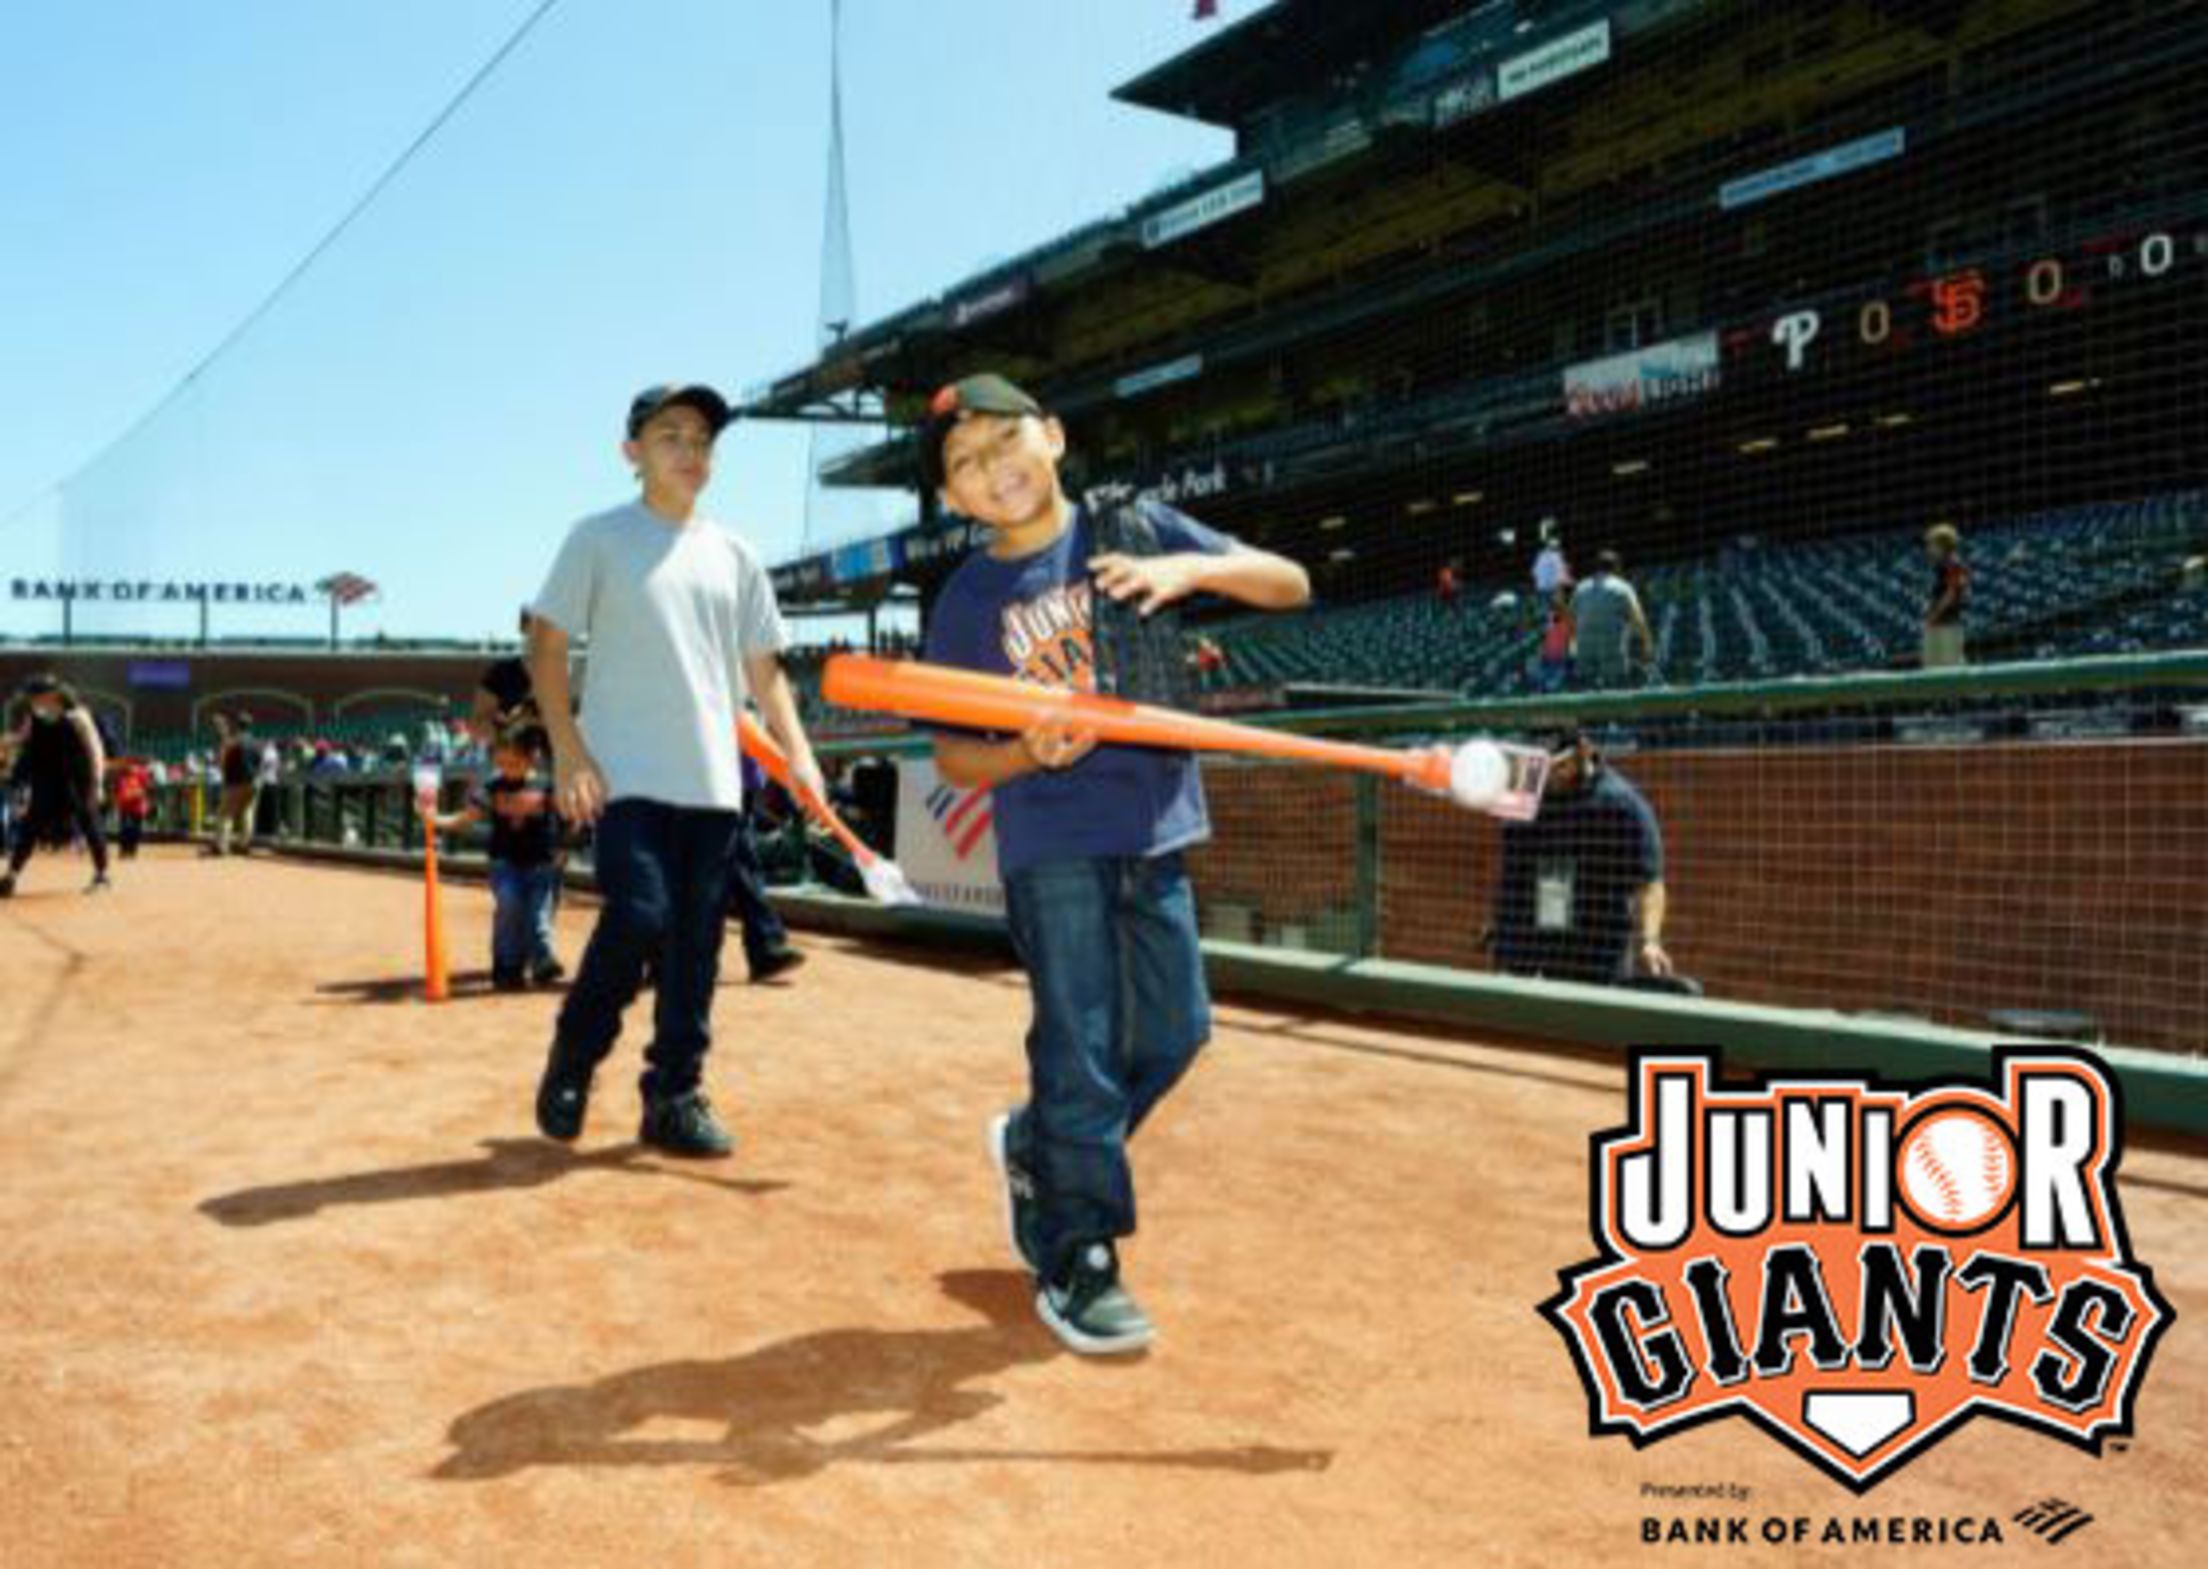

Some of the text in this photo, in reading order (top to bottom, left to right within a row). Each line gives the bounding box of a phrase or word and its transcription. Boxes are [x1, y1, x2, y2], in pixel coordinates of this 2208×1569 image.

[1772, 310, 1820, 369] P
[11, 579, 306, 602] BANK OF AMERICA
